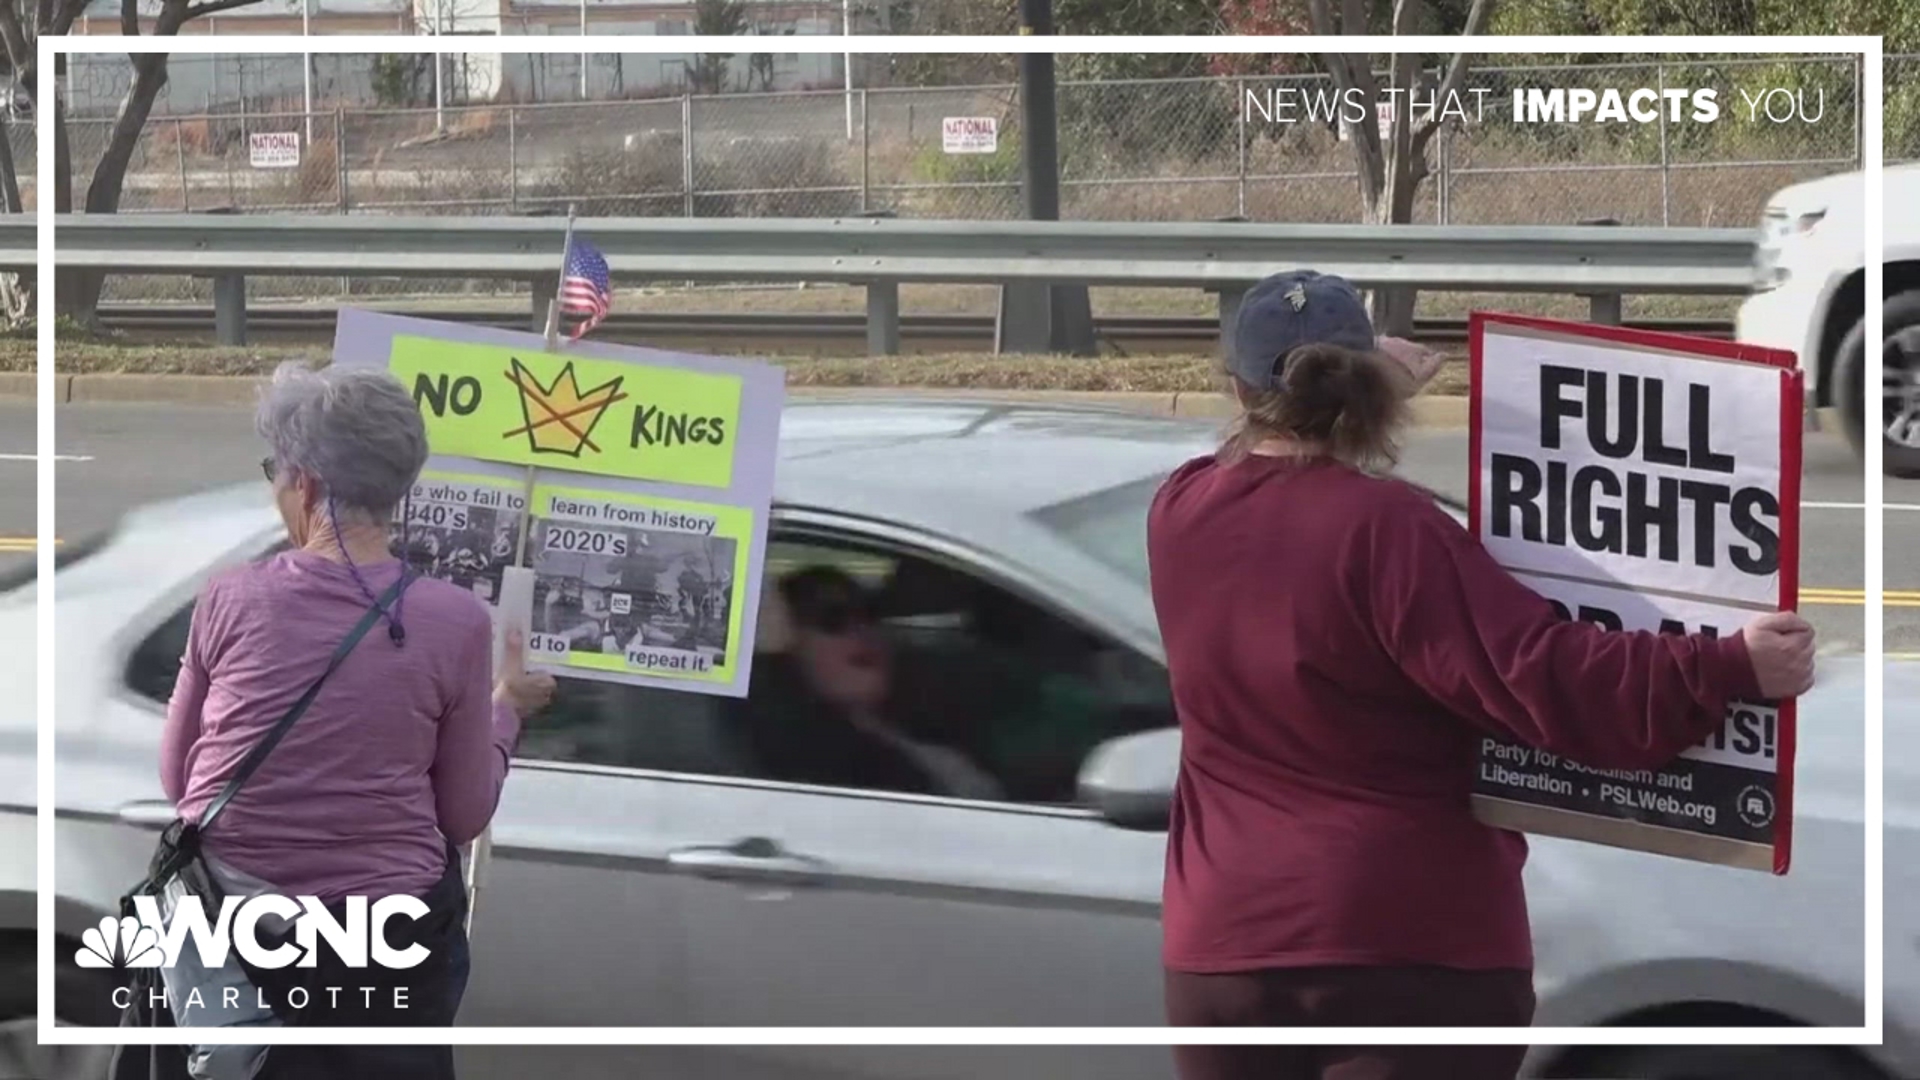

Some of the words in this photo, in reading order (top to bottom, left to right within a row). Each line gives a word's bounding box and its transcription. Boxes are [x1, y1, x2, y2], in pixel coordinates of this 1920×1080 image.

[251, 134, 297, 149] NATIONAL
[946, 119, 994, 135] NATIONAL
[413, 372, 482, 417] NO
[630, 404, 724, 448] KINGS
[1540, 364, 1735, 474] FULL
[428, 485, 468, 503] who
[473, 488, 501, 507] fail
[507, 494, 525, 510] to
[551, 497, 598, 518] learn
[603, 503, 646, 524] from
[651, 509, 716, 537] history
[1490, 452, 1780, 576] RIGHTS
[547, 527, 626, 556] 2020's
[547, 637, 566, 654] to
[628, 648, 688, 671] repeat
[693, 655, 709, 673] it.
[1481, 738, 1532, 772] Party
[1534, 748, 1559, 769] for
[1656, 772, 1693, 792] and
[1480, 762, 1573, 796] Liberation
[1599, 782, 1717, 826] PSLWeb.org
